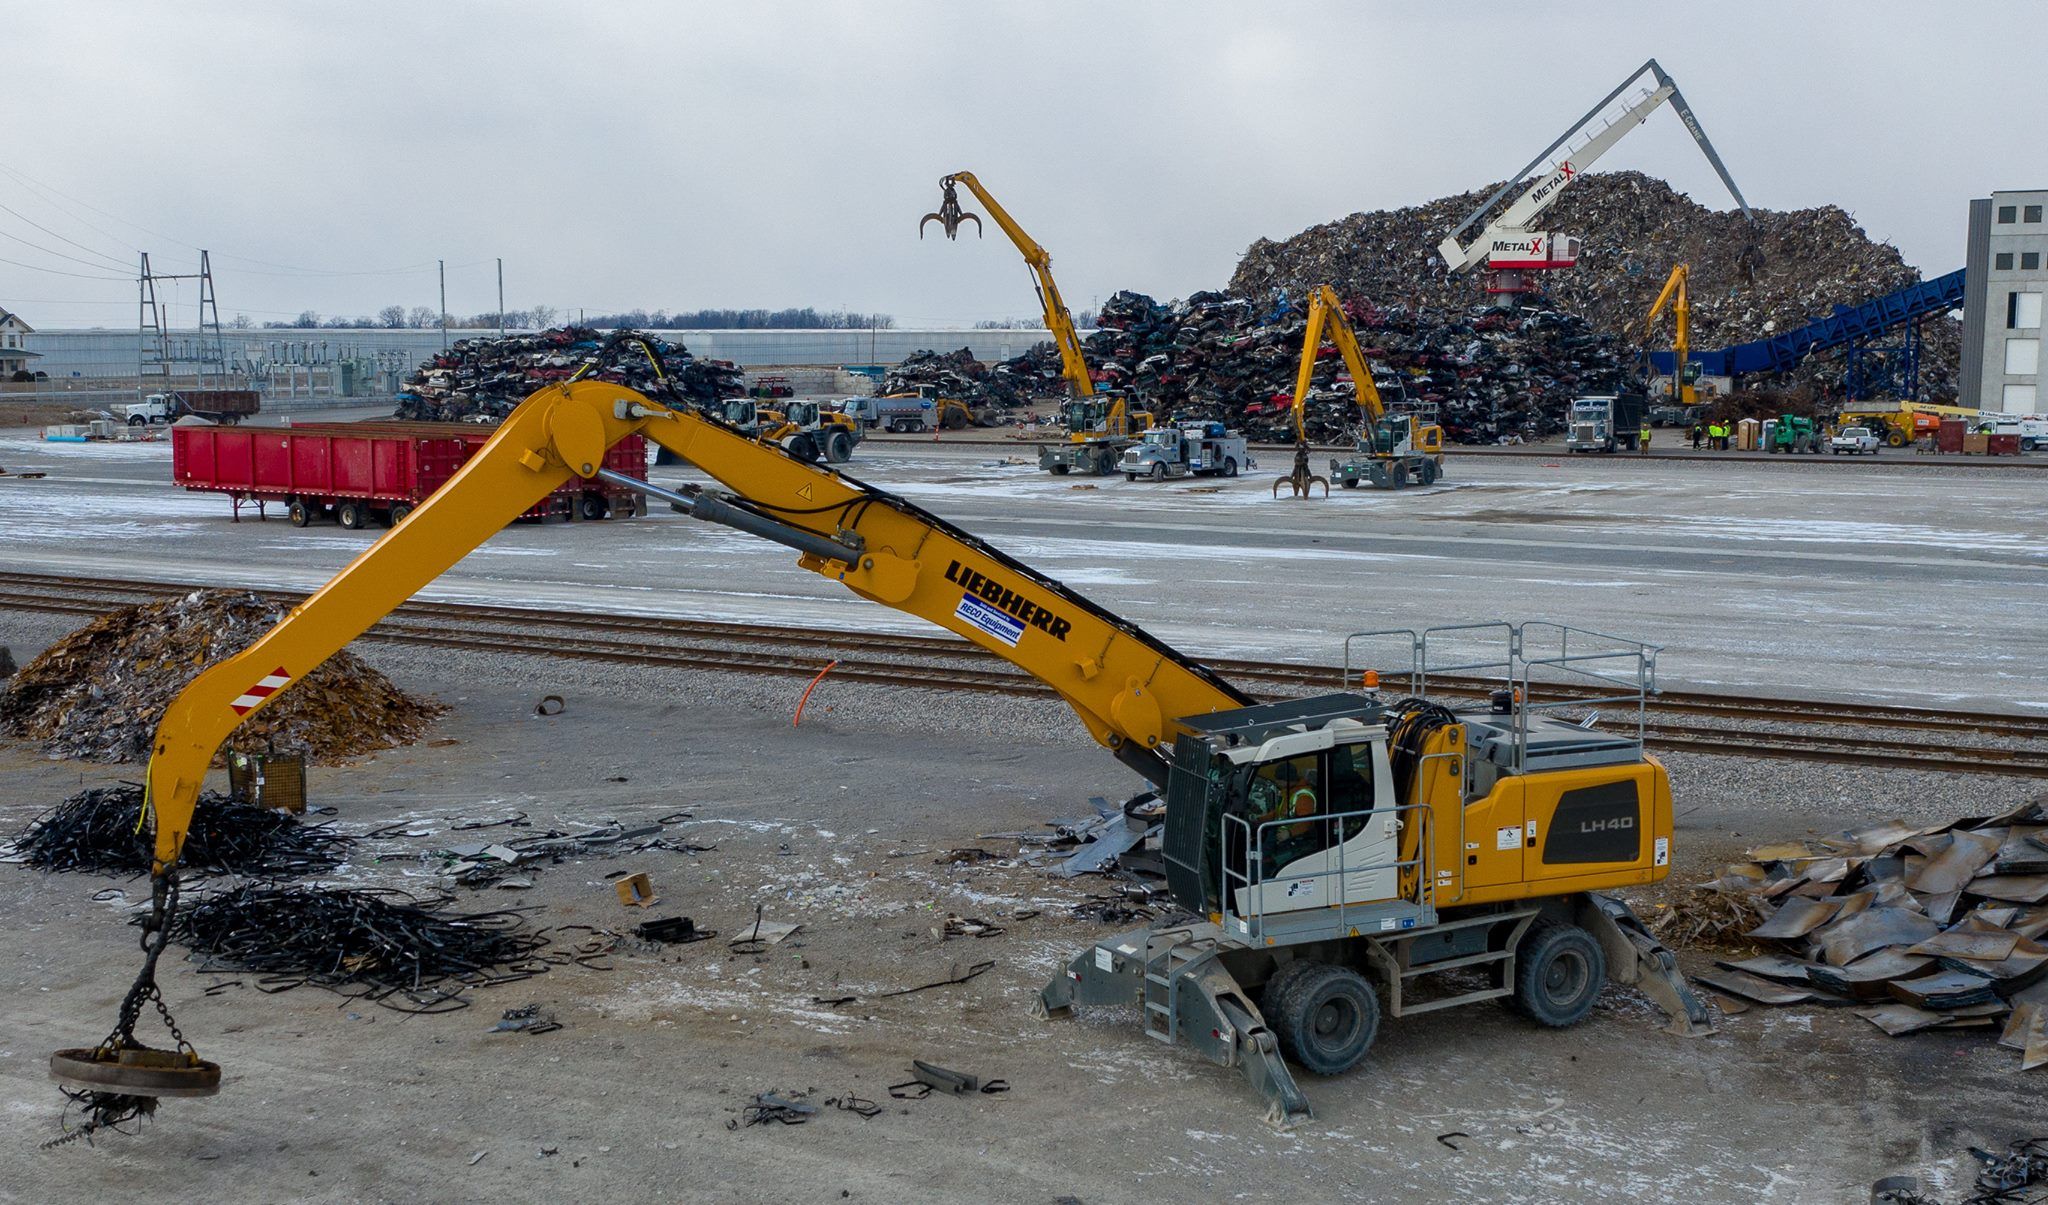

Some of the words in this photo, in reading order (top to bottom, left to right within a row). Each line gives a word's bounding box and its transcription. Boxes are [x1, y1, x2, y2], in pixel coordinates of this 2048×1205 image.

[944, 560, 1071, 642] LIEBHERR
[961, 603, 982, 618] RECO
[981, 614, 1020, 639] Equipment
[1581, 817, 1633, 832] LH40
